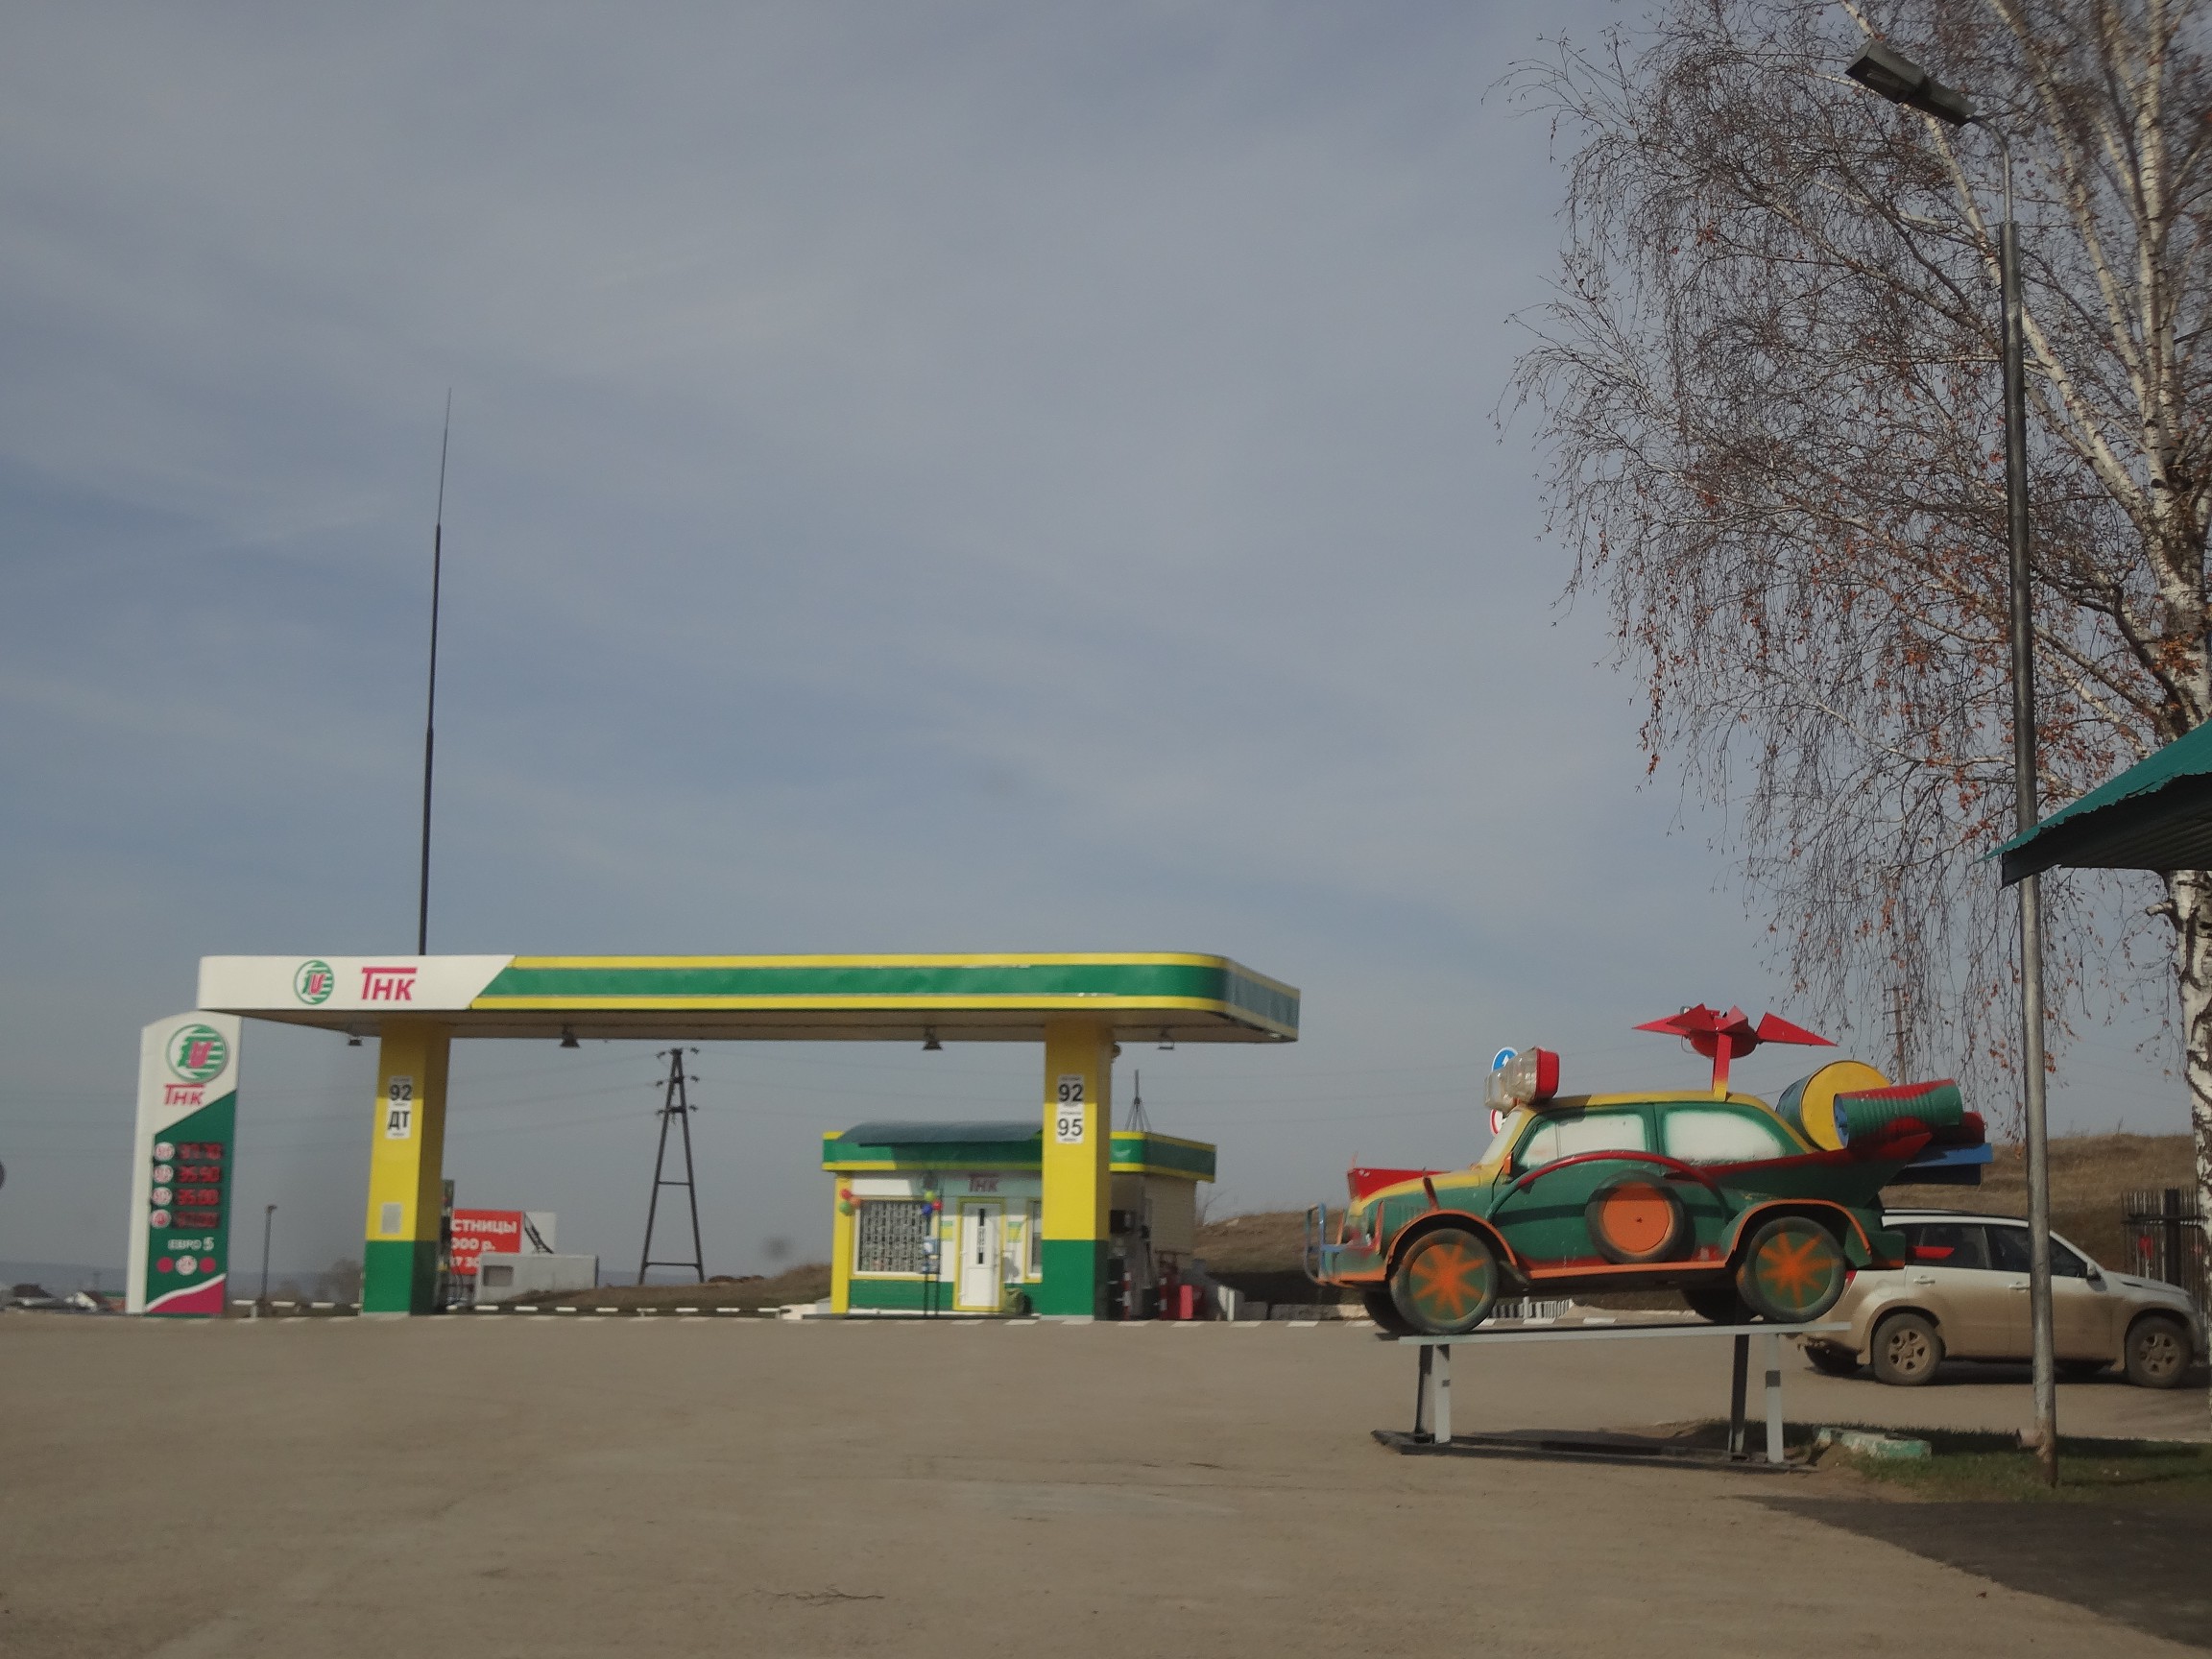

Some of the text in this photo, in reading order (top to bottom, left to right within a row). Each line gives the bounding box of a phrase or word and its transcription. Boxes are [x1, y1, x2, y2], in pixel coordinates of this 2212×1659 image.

[361, 966, 418, 1000] ТНК
[164, 1083, 205, 1105] ТНК
[390, 1084, 412, 1101] 92
[1058, 1083, 1084, 1102] 92
[387, 1111, 410, 1130] ДТ
[1058, 1118, 1083, 1137] 95
